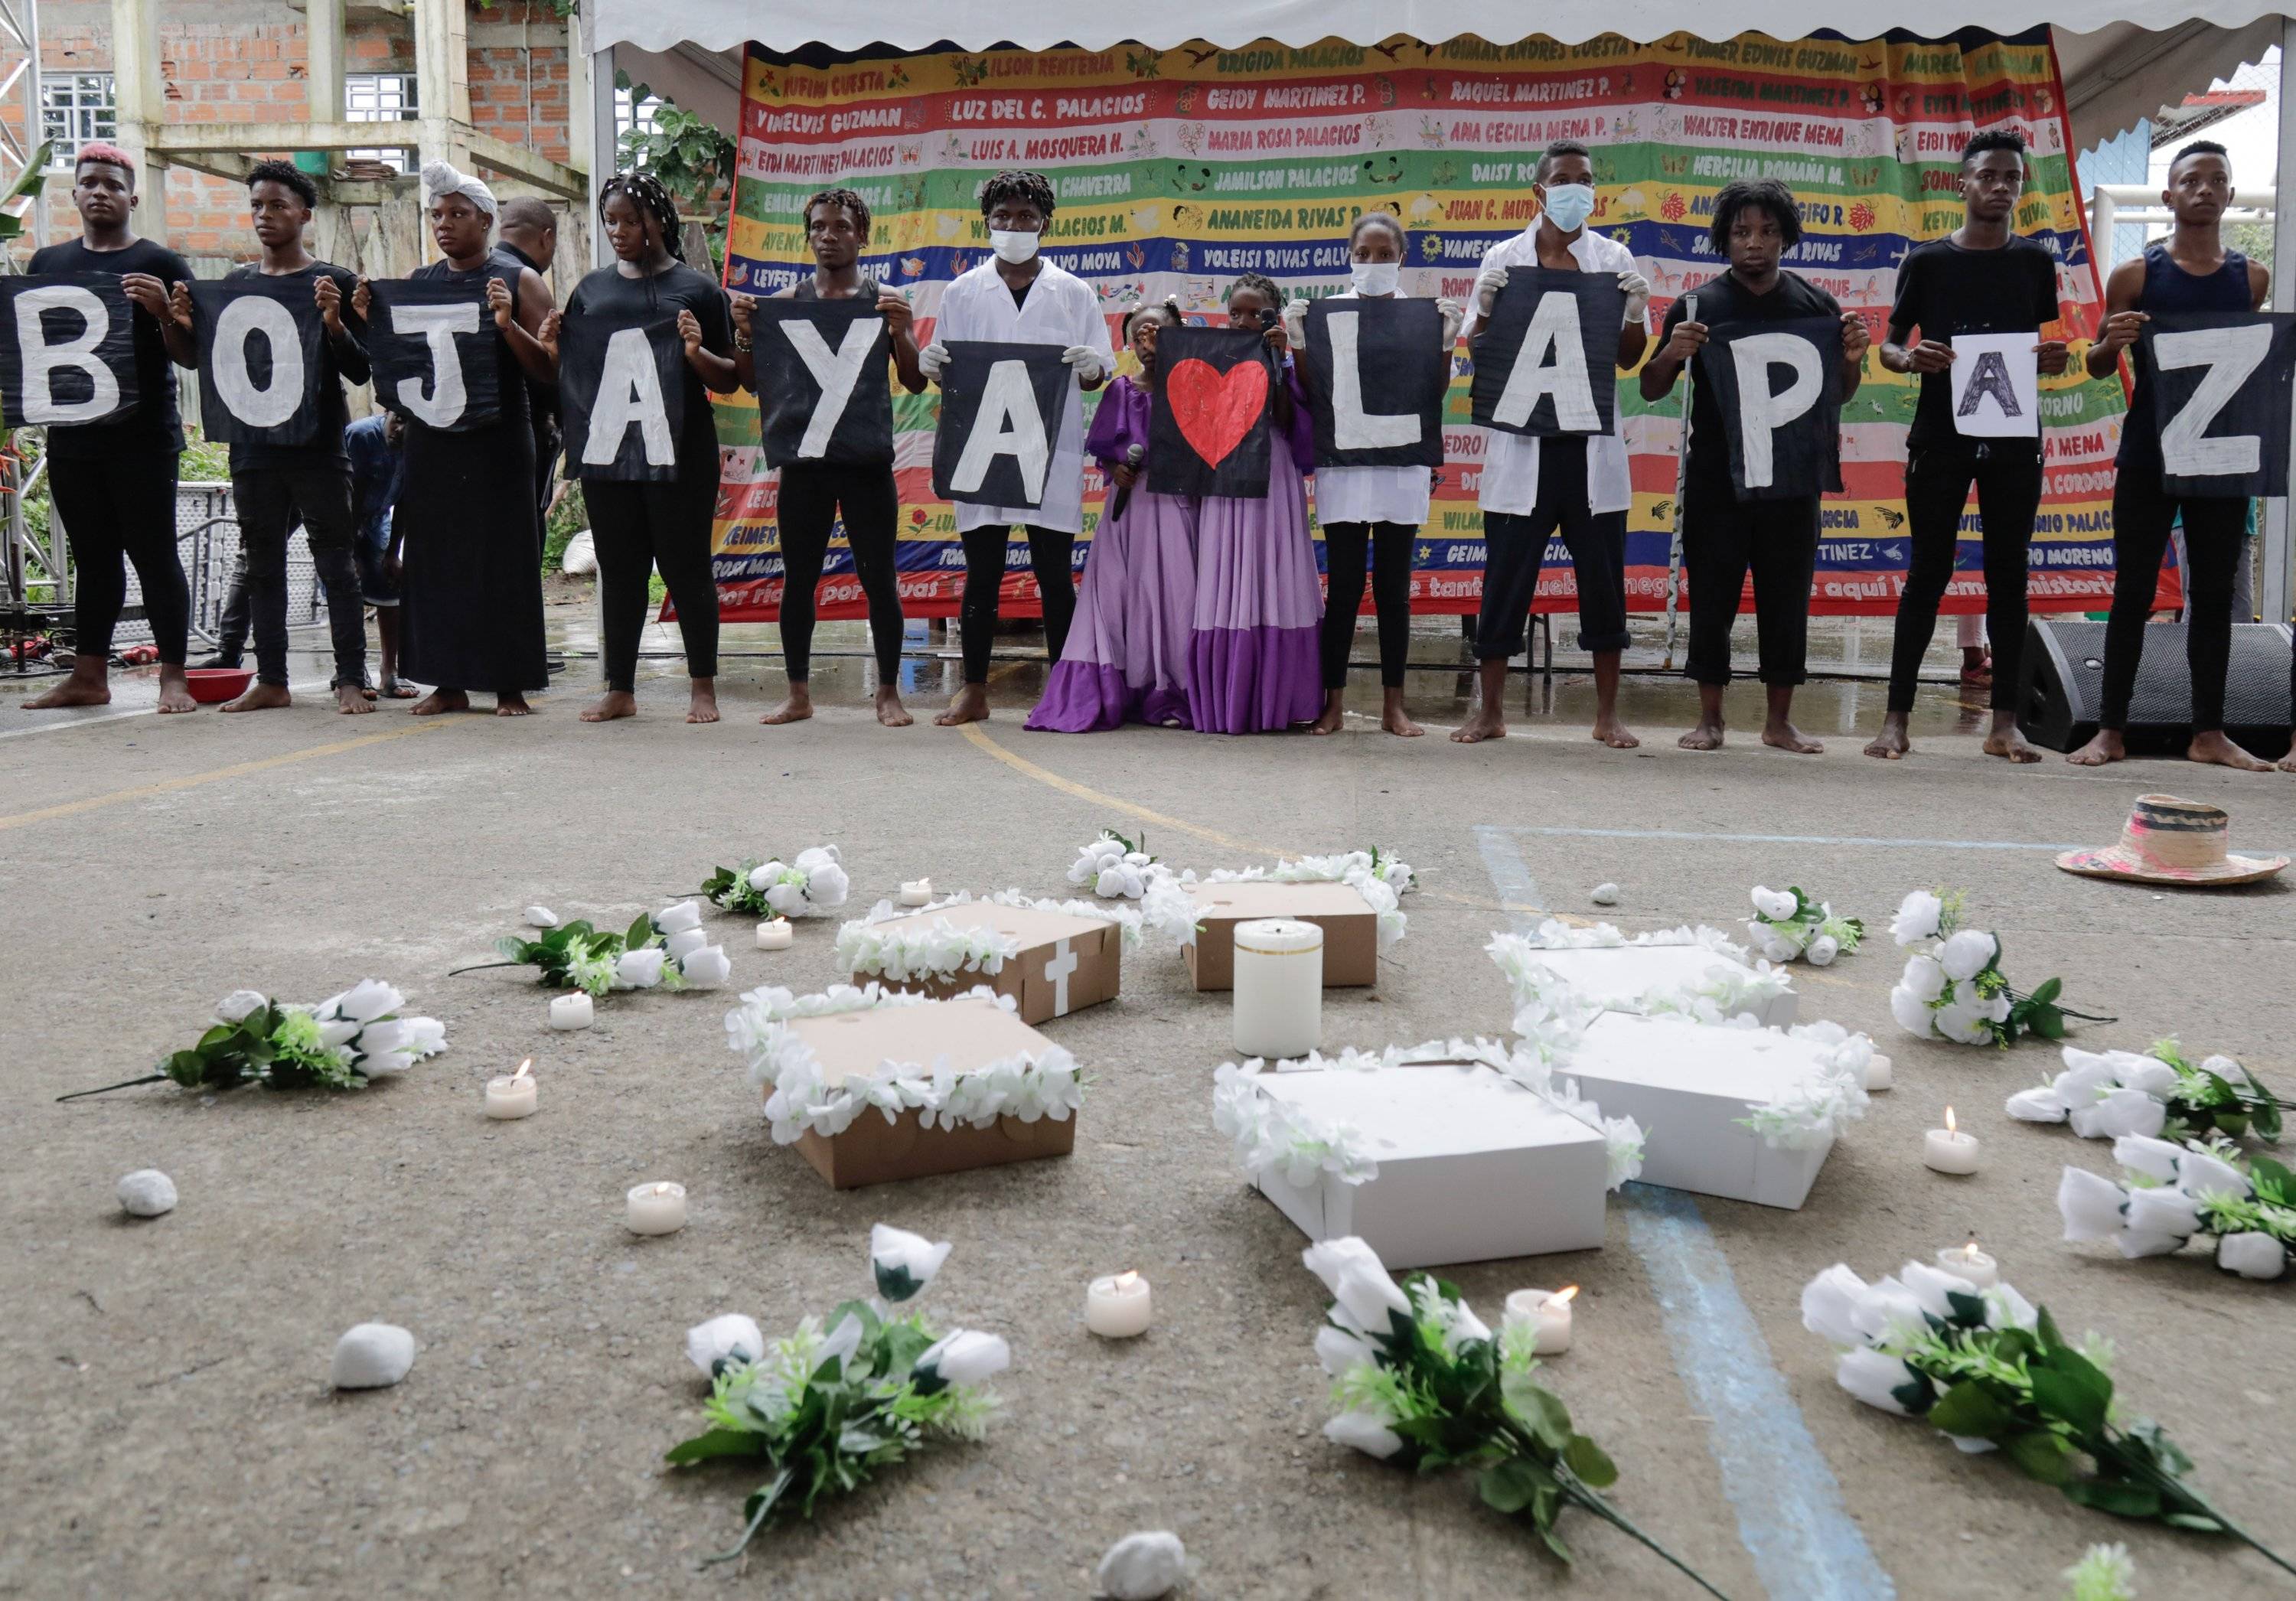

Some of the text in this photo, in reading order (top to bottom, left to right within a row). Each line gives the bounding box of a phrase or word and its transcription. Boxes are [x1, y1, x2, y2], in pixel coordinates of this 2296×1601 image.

[1217, 46, 1367, 73] BRIGIDA PALACIOS
[1505, 40, 1567, 62] ANDRES
[1571, 37, 1629, 58] CUESTA
[1795, 47, 1858, 74] GUZMAN
[831, 71, 885, 96] CUESTA
[1207, 83, 1365, 110] GEIDY MARTINEZ P.
[1450, 77, 1611, 103] RAQUEL MARTINEZ P.
[952, 93, 1146, 121] LUZ DEL C. PALACIOS
[831, 107, 902, 134] GUZMAN
[1450, 116, 1607, 144] ANA CECILIA MENA P.
[1684, 115, 1844, 147] WALTER ENRIQUE MENA
[970, 132, 1124, 161] LUIS A. MOSQUERA H.
[1208, 123, 1362, 152] MARIA ROSA PALACIOS
[783, 154, 840, 176] MARTINEZ
[840, 145, 895, 171] PALACIOS
[1472, 163, 1512, 183] DAISY
[1693, 155, 1760, 180] HERCILIA
[1828, 166, 1845, 187] M.
[1061, 172, 1131, 198] CHAVERRA
[1213, 164, 1358, 191] JAMILSON PALACIOS
[1109, 214, 1127, 233] M.
[1207, 208, 1293, 230] ANANEIDA
[1297, 206, 1347, 230] RIVAS
[1445, 200, 1483, 221] JUAN
[1923, 210, 1963, 231] KEVIN
[1081, 250, 1120, 270] MOYA
[1204, 248, 1261, 269] YOLEISI
[1266, 247, 1309, 269] RIVAS
[1802, 241, 1843, 262] RIVAS
[2058, 432, 2105, 457] MENA
[2047, 546, 2113, 566] MORENO
[820, 584, 863, 606] por
[1825, 576, 1887, 601] aquí
